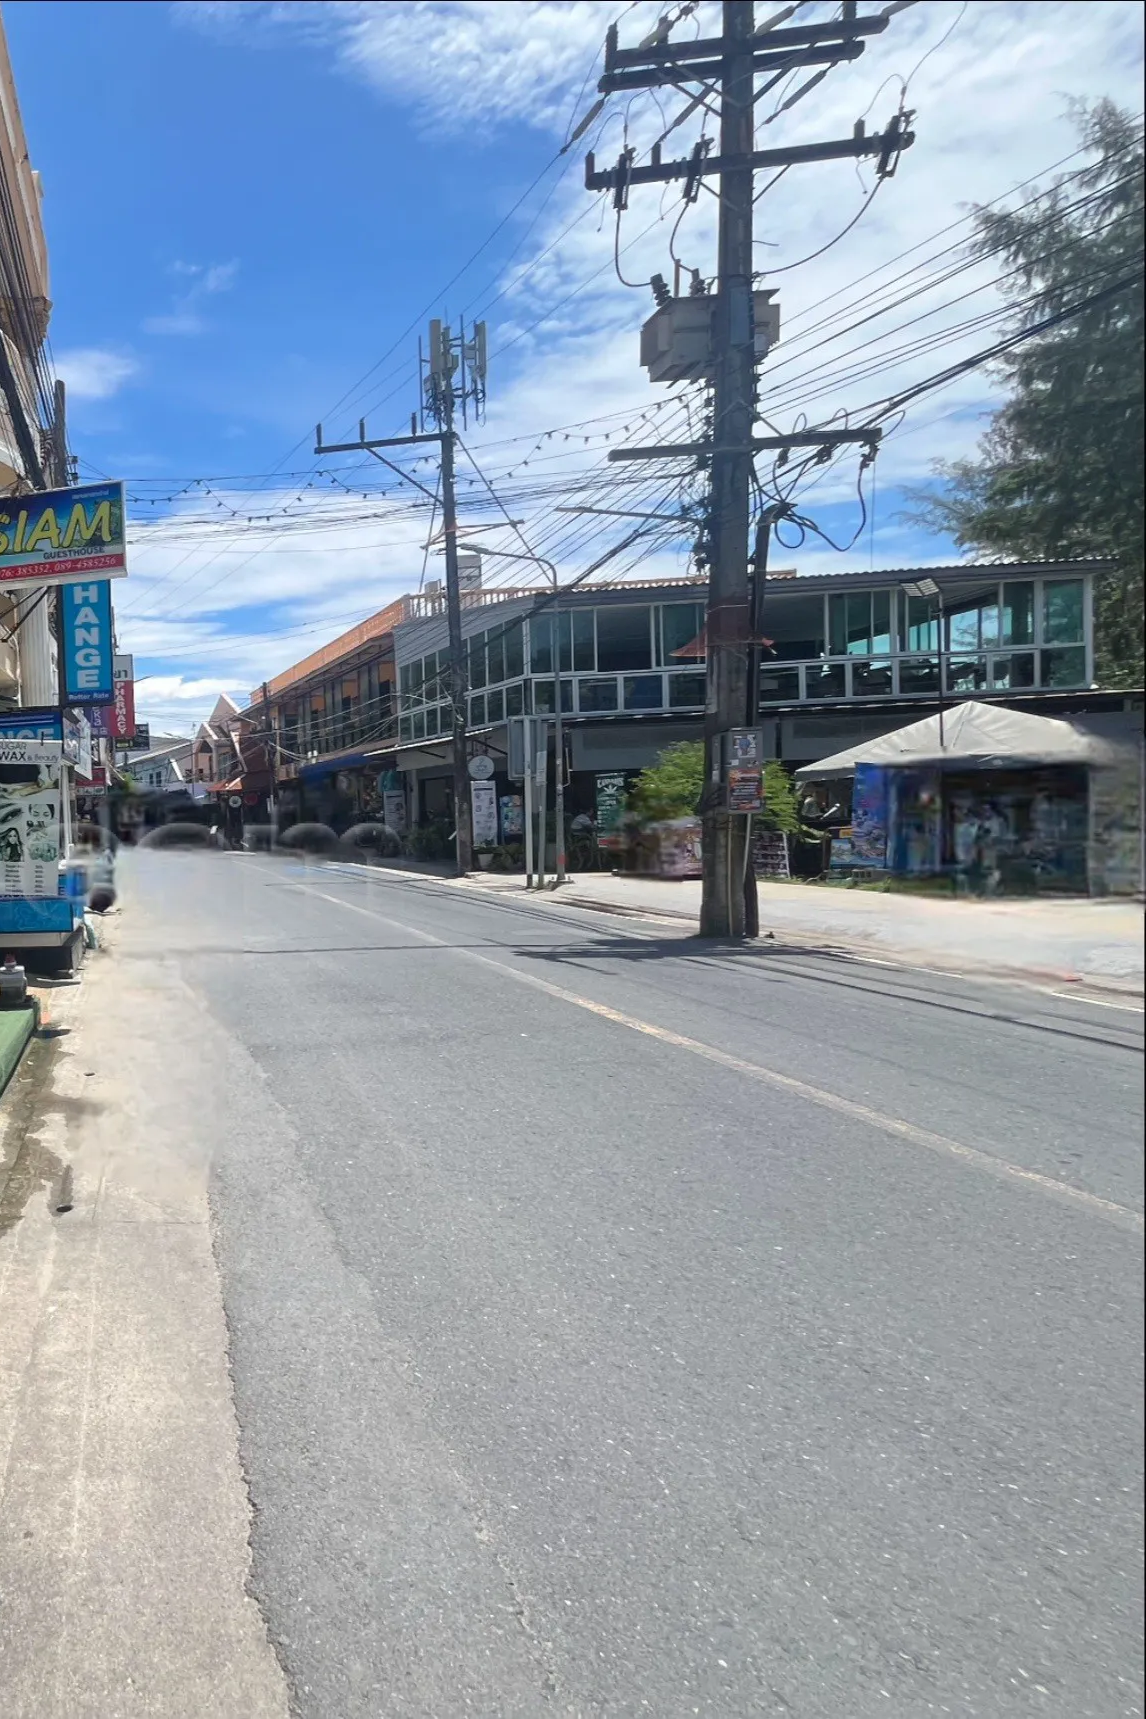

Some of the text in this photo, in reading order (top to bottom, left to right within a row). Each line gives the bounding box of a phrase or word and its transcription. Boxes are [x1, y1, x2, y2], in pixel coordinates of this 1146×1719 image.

[43, 547, 105, 560] GUESTHOUSE
[73, 584, 101, 688] HANGE
[115, 682, 128, 735] PHARMACY
